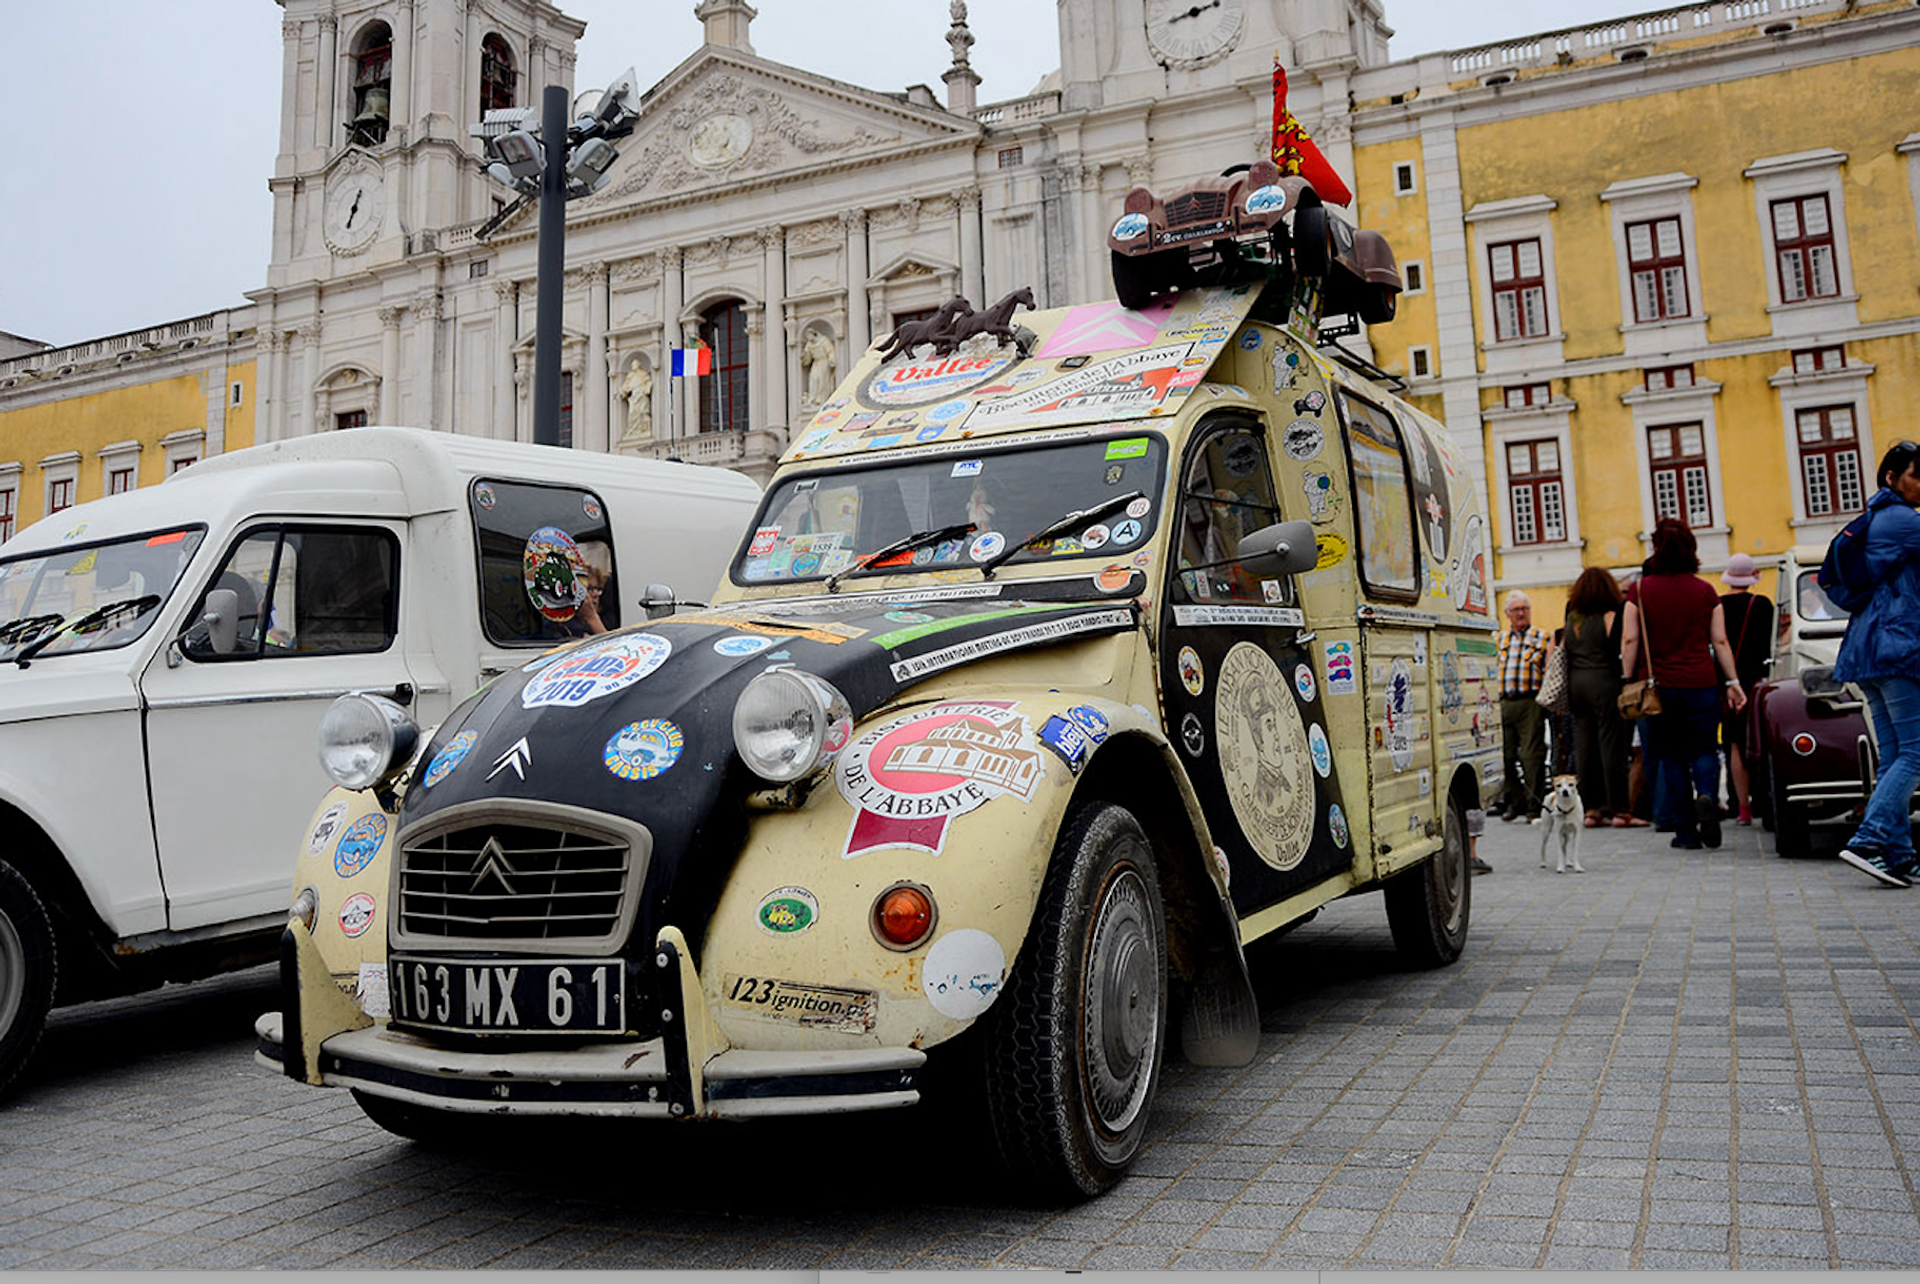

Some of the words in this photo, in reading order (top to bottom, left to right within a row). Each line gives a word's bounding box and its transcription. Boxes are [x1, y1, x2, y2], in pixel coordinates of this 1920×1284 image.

[892, 357, 993, 383] Vallée
[531, 679, 597, 704] 2019
[659, 721, 685, 749] CLUB
[859, 703, 1010, 747] BISCUITERIE
[604, 755, 660, 781] CASSIS
[844, 765, 868, 790] DE
[858, 782, 984, 816] L'ABBAYE
[396, 963, 450, 1023] 163
[465, 967, 519, 1027] MX
[547, 966, 610, 1027] 61
